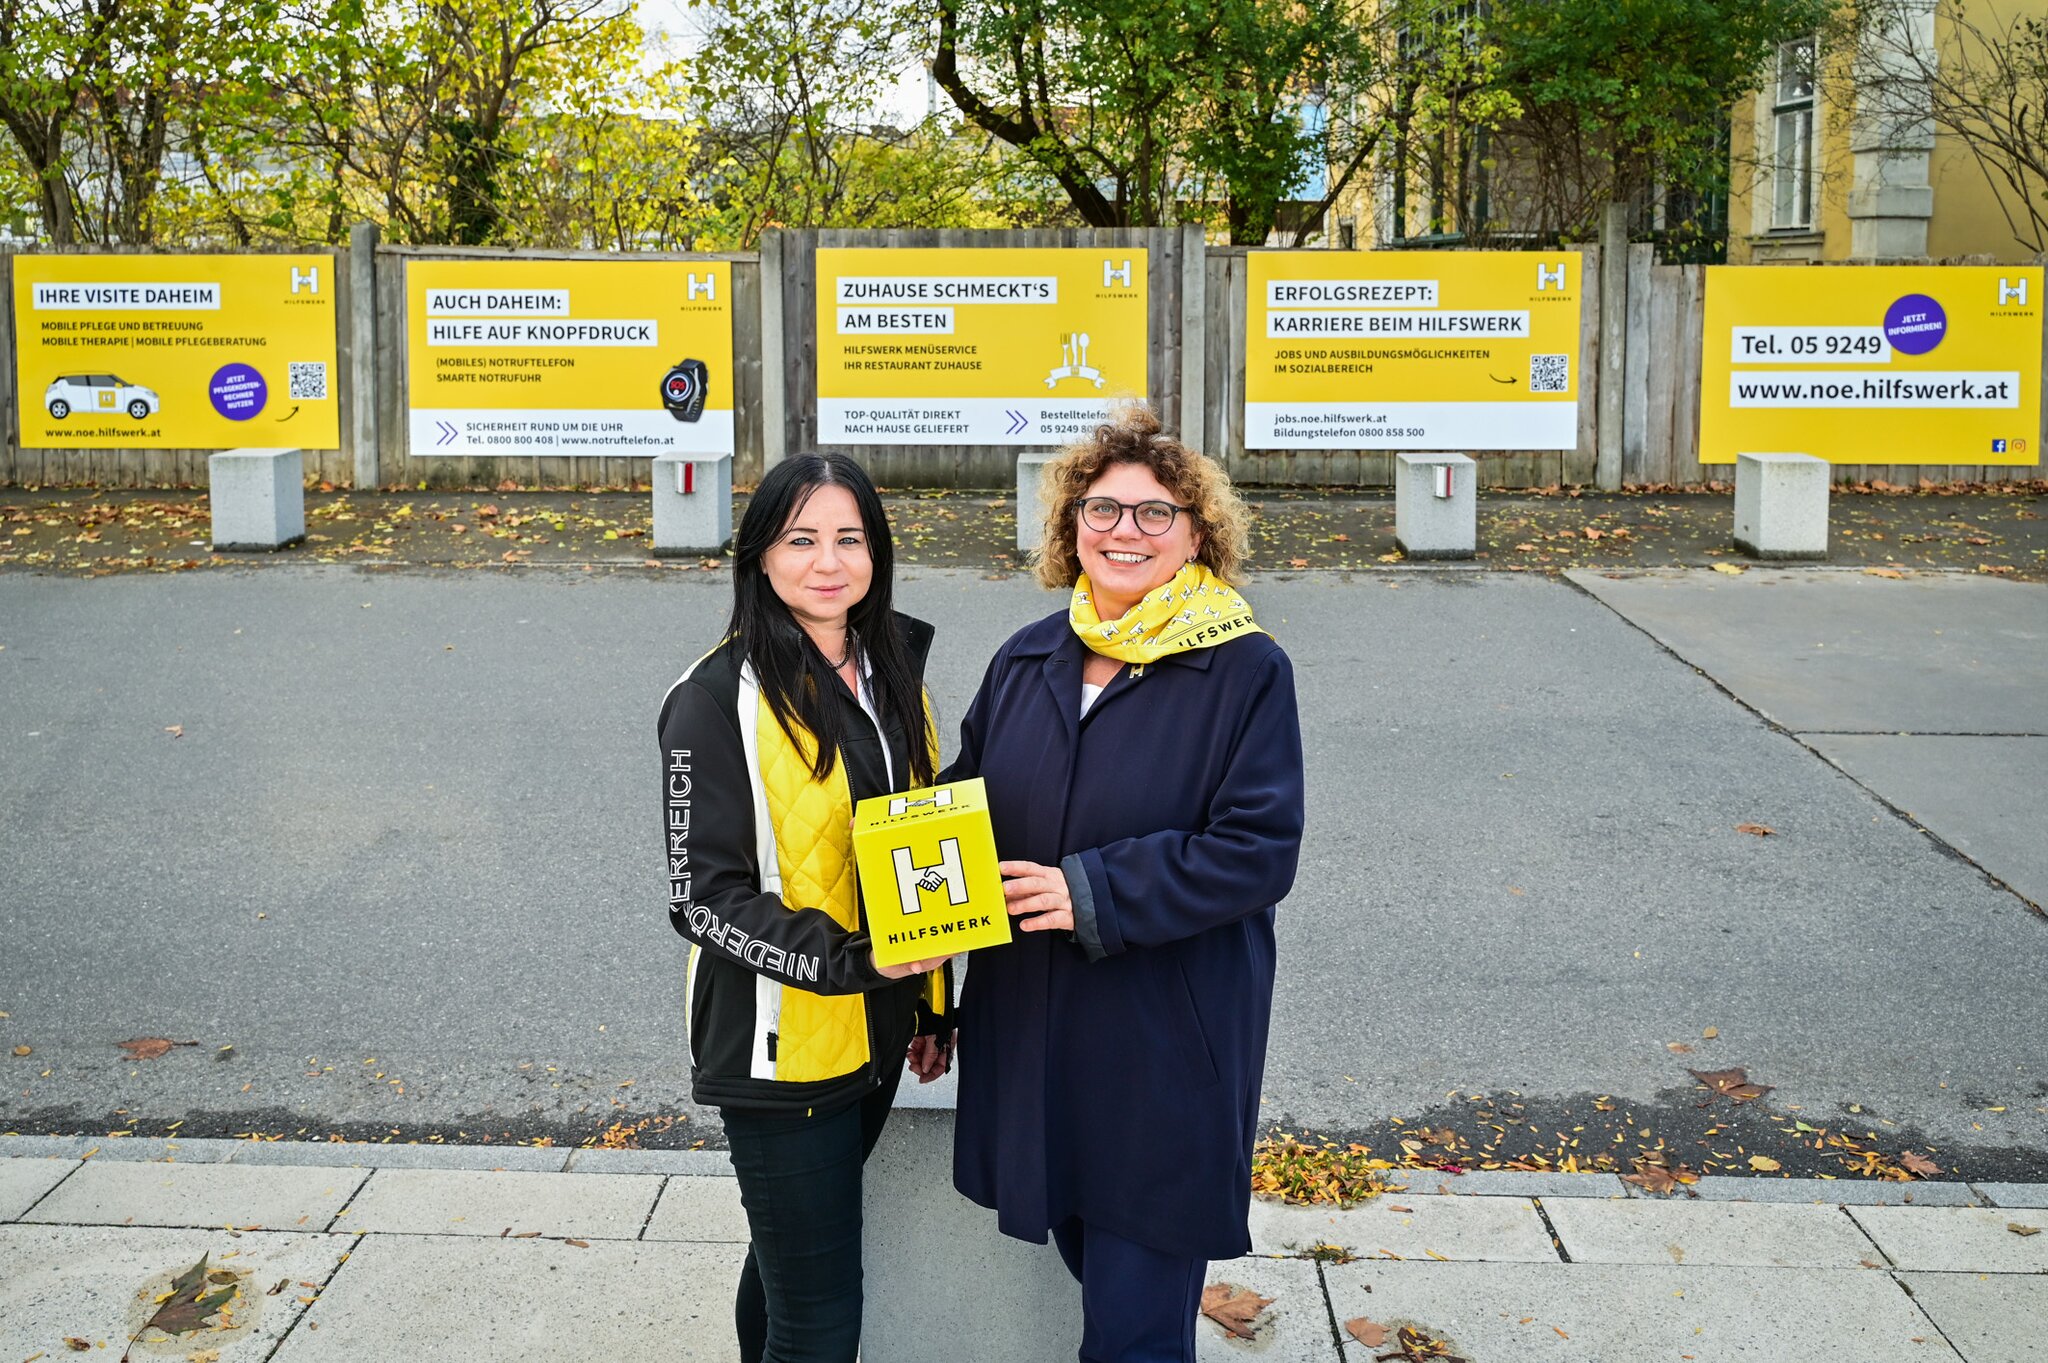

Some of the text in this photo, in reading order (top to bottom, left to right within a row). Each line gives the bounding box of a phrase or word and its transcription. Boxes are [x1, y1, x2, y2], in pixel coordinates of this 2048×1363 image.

[40, 289, 213, 303] IHRE VISITE DAHEIM
[844, 283, 928, 298] ZUHAUSE
[1275, 286, 1432, 301] ERFOLGSREZEPT:
[433, 295, 562, 309] AUCH DAHEIM:
[845, 314, 946, 328] AM BESTEN
[1902, 313, 1926, 324] JETZT
[41, 322, 203, 331] MOBILE PFLEGE UND BETREUUNG
[1274, 317, 1522, 332] KARRIERE BEIM HILFSWERK
[434, 325, 650, 340] HILFE AUF KNOPFDRUCK
[42, 337, 267, 346] MOBILE THERAPIE MOBILE PFLEGEBERATUNG
[1742, 335, 1881, 354] Tel. 05 9249
[844, 344, 977, 354] HILFSWERK MENÜSERVICE
[1274, 348, 1490, 359] JOBS UND AUSBILDUNGSMÖGLICHKEITEN
[436, 357, 575, 369] (MOBILES) NOTRUFTELEFON
[844, 361, 982, 370] IHR RESTAURANT ZUHAUSE
[1274, 364, 1373, 373] IM SOZIALBEREICH
[436, 373, 542, 382] SMARTE NOTRUFUHR
[1738, 380, 2008, 399] www.noe.hilfswerk.at
[844, 409, 961, 421] TOP-QUALITÄT DIREKT
[1274, 414, 1387, 425] jobs.noe.hilfswerk.at
[466, 422, 623, 431] SICHERHEIT RUND UM DIE UHR
[845, 425, 969, 433] NACH HAUSE GELIEFERT
[1040, 425, 1052, 433] 05
[1055, 425, 1079, 433] 9249
[45, 428, 161, 437] www.noe.hilfswerk.at
[1274, 428, 1425, 439] Bildungstelefon 0800 858 500
[466, 436, 674, 446] Tel. 0800 800 408 www.notruftelefon.at
[888, 915, 991, 944] HILFSWERK
